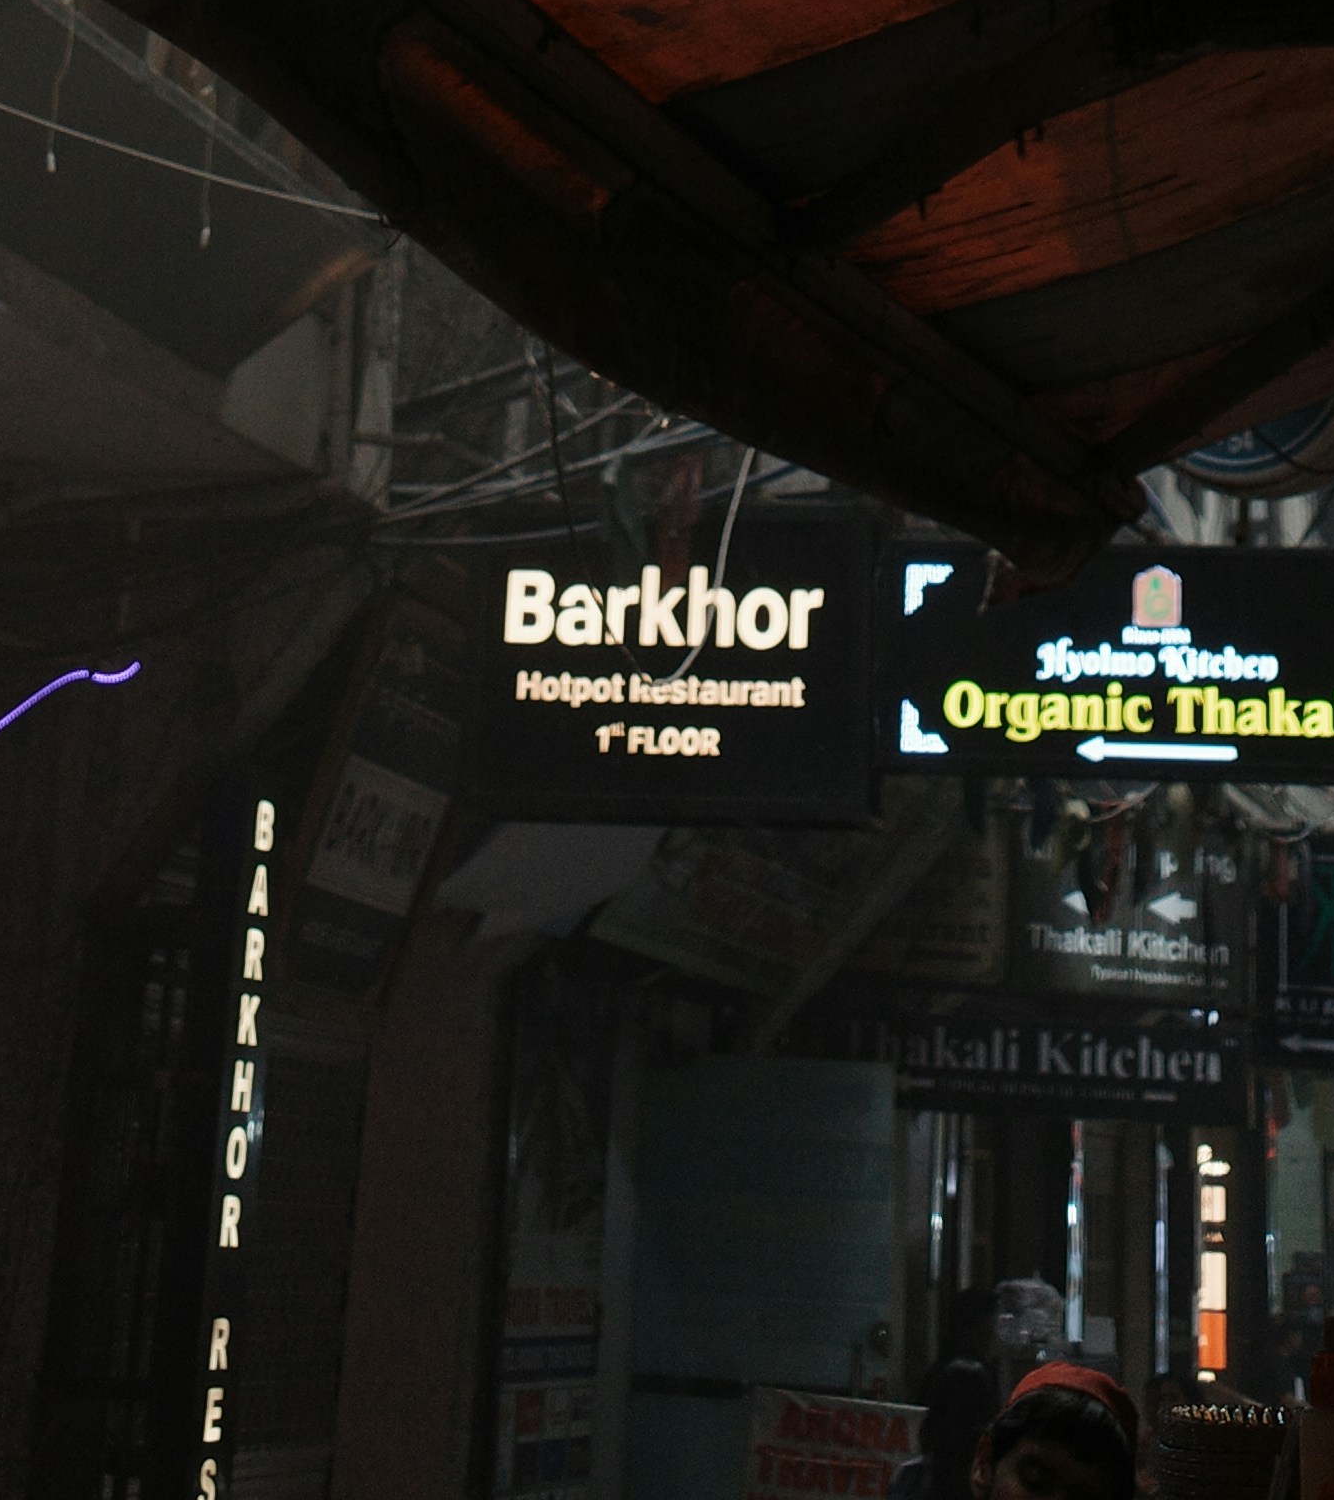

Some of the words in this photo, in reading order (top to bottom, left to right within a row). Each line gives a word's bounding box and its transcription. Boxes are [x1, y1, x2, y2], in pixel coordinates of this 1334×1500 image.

[504, 565, 825, 653] Barkhor
[1157, 645, 1279, 683] Kitchen
[515, 671, 625, 708] Hotpot
[628, 672, 806, 709] Restaurant
[942, 678, 1155, 743] Organic
[627, 725, 722, 758] FLOOR
[1028, 922, 1123, 957] Thakali
[218, 799, 276, 1249] BARKHOR
[1035, 1029, 1223, 1084] Kitchen
